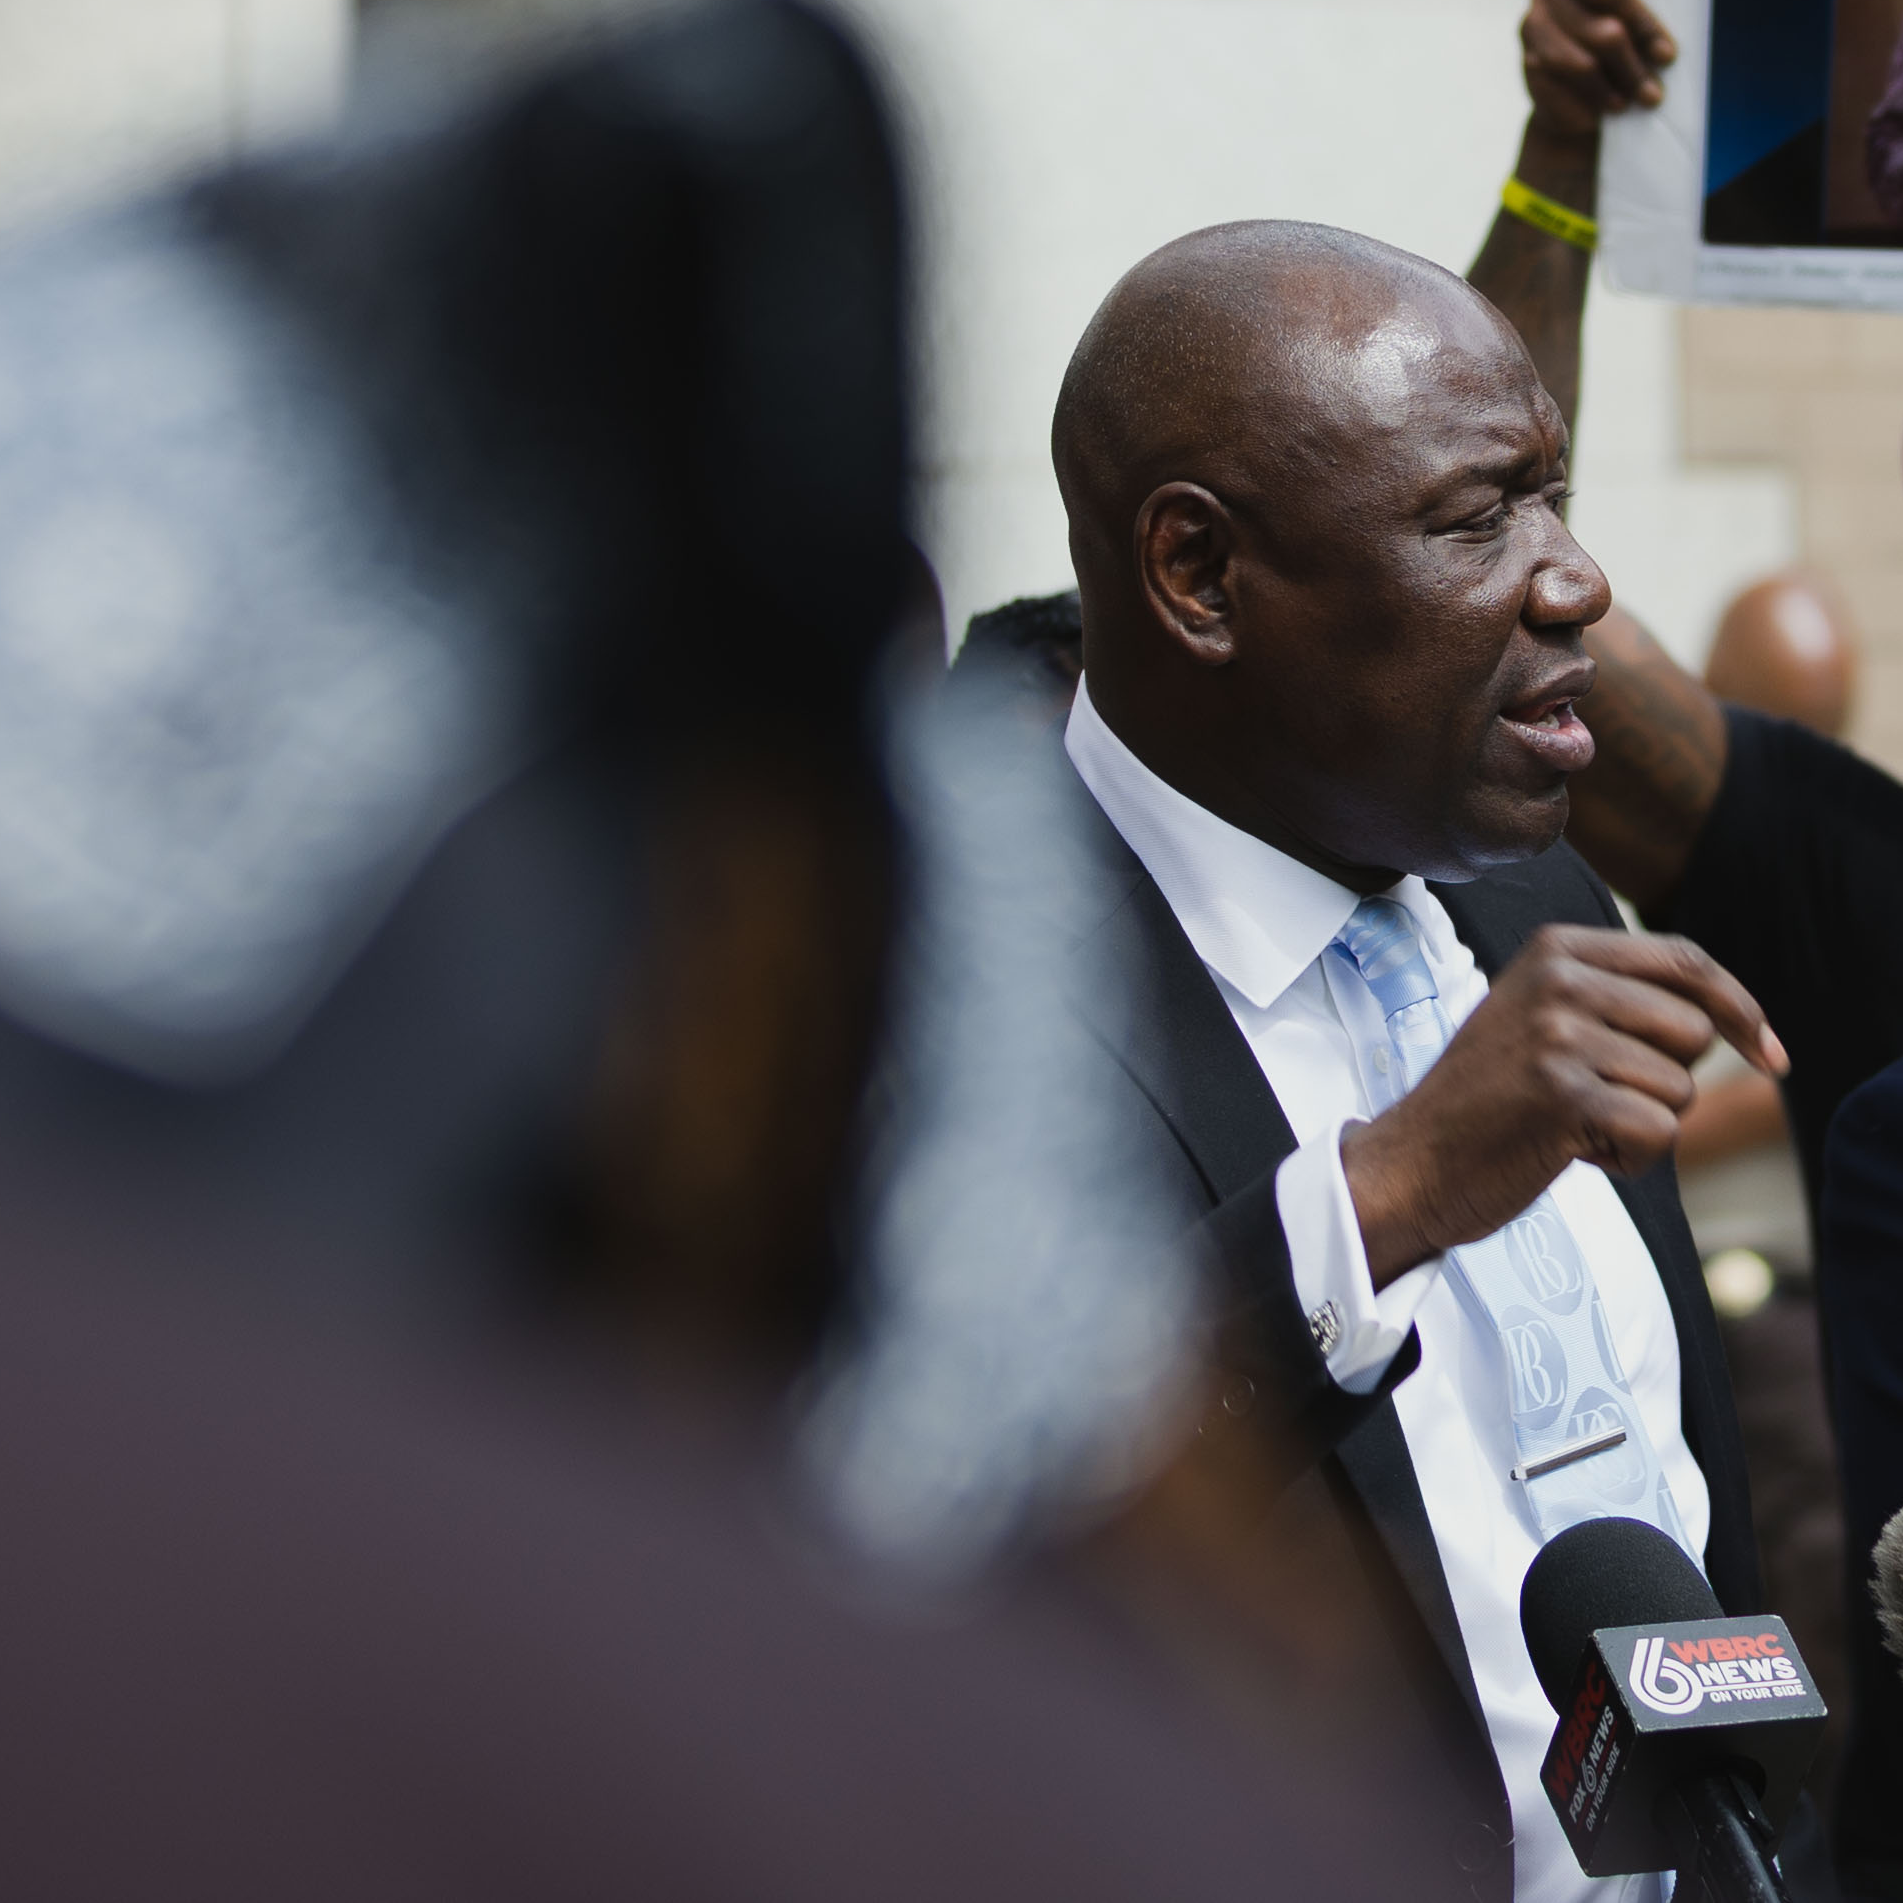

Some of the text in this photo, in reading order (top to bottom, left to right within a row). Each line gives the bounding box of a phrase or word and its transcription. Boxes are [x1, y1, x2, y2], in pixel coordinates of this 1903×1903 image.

[1629, 1637, 1704, 1715] 6
[1667, 1633, 1785, 1664] WBRC
[1695, 1657, 1797, 1686] NEWS
[1549, 1661, 1606, 1801] WBRC
[1710, 1683, 1807, 1703] ON YOUR SIDE
[1569, 1785, 1587, 1823] FOX
[1589, 1705, 1615, 1768] NEWS
[1585, 1742, 1621, 1832] ON YOUR SIDE
